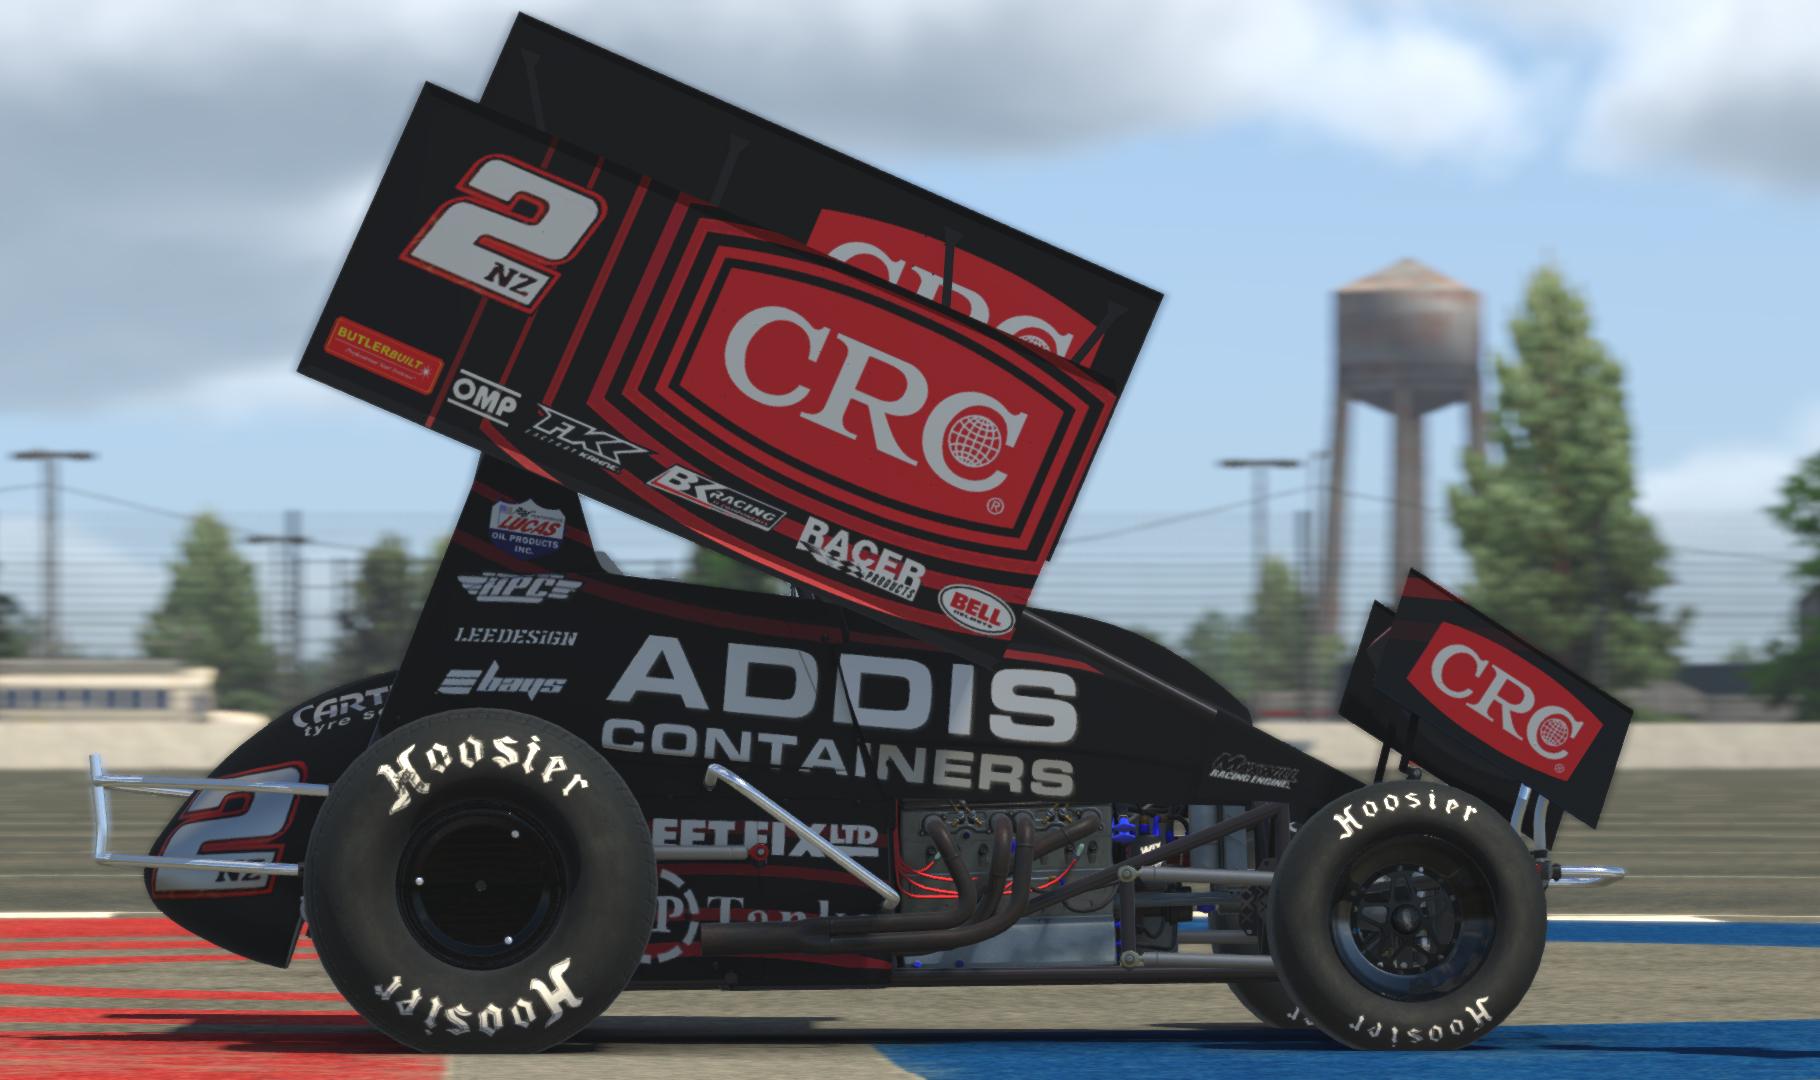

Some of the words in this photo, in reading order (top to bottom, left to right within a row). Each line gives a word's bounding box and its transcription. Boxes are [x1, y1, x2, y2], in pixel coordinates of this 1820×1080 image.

[406, 156, 603, 308] 2
[484, 261, 539, 297] NZ
[337, 326, 424, 370] BUTLERBUILT
[452, 376, 518, 418] OMP
[724, 305, 1028, 493] CRC
[498, 515, 561, 537] LUCAS
[709, 489, 777, 523] RACING
[491, 532, 508, 541] OIL
[509, 534, 560, 550] PRODUCTS
[797, 515, 927, 586] RACER
[865, 571, 916, 600] PRODUCTS
[951, 591, 1002, 627] BELL
[292, 684, 393, 728] CART
[606, 634, 1079, 745] ADDIS
[1431, 643, 1584, 761] CRC
[304, 717, 352, 737] tyre
[376, 735, 589, 816] Hoosier
[601, 717, 1075, 798] CONTAINERS
[155, 767, 301, 892] 2
[830, 824, 879, 846] LTD
[1333, 789, 1479, 840] Hoosier
[374, 957, 584, 1036] Hoosier
[1349, 995, 1493, 1047] Hoosier
